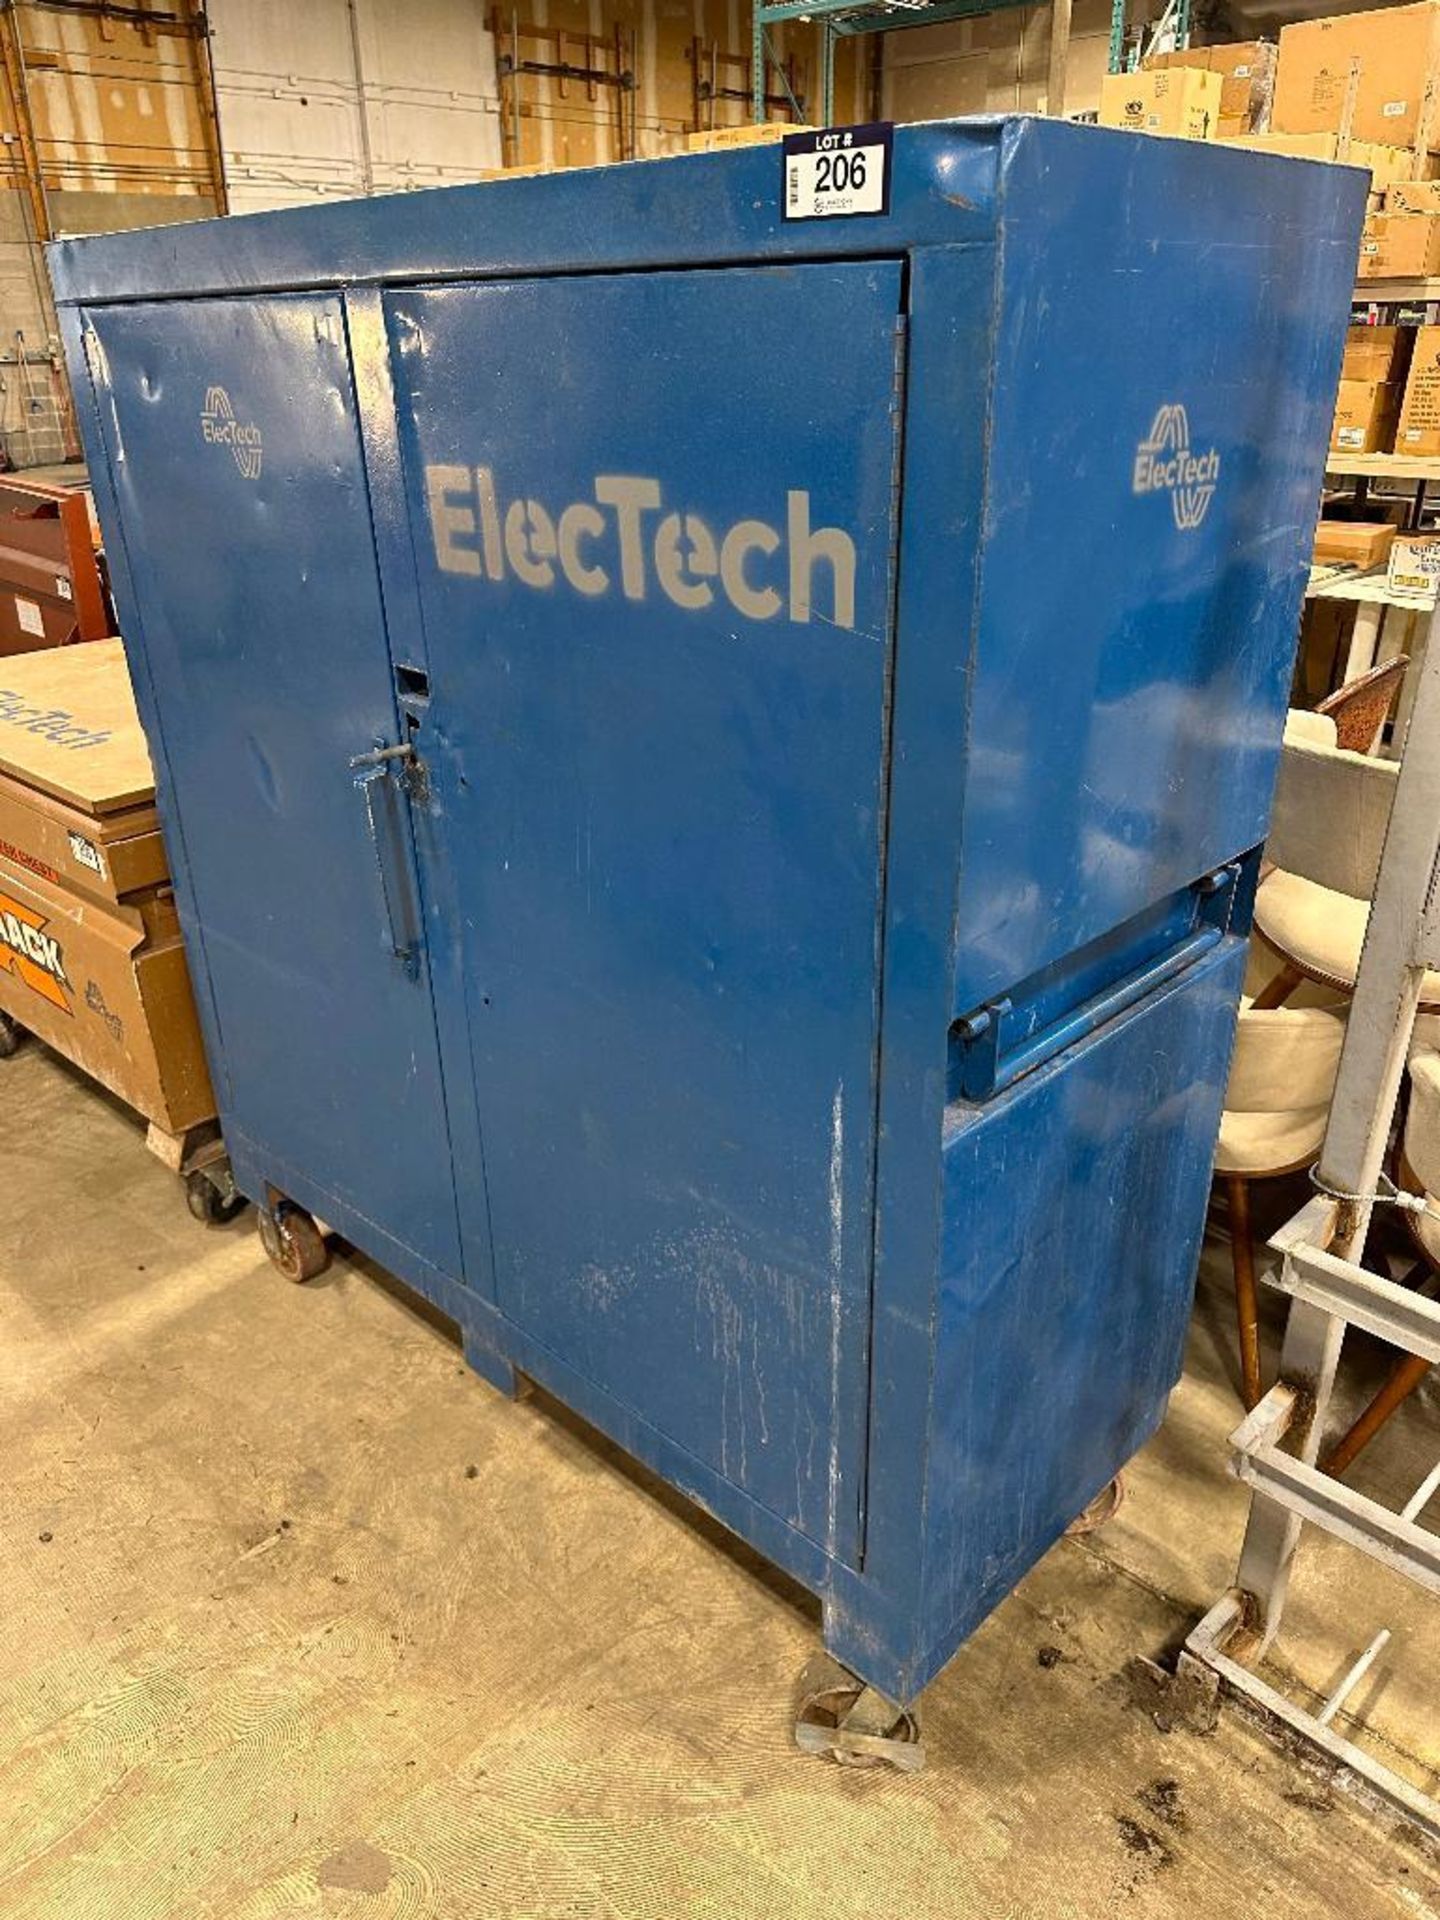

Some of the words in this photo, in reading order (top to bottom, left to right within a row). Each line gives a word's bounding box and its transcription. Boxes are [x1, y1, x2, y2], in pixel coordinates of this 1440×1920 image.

[815, 134, 840, 151] LOT
[842, 132, 853, 148] #
[814, 151, 866, 193] 206
[202, 419, 261, 446] ElecTech
[1133, 447, 1220, 494] ElecTech
[424, 463, 857, 629] ElecTech
